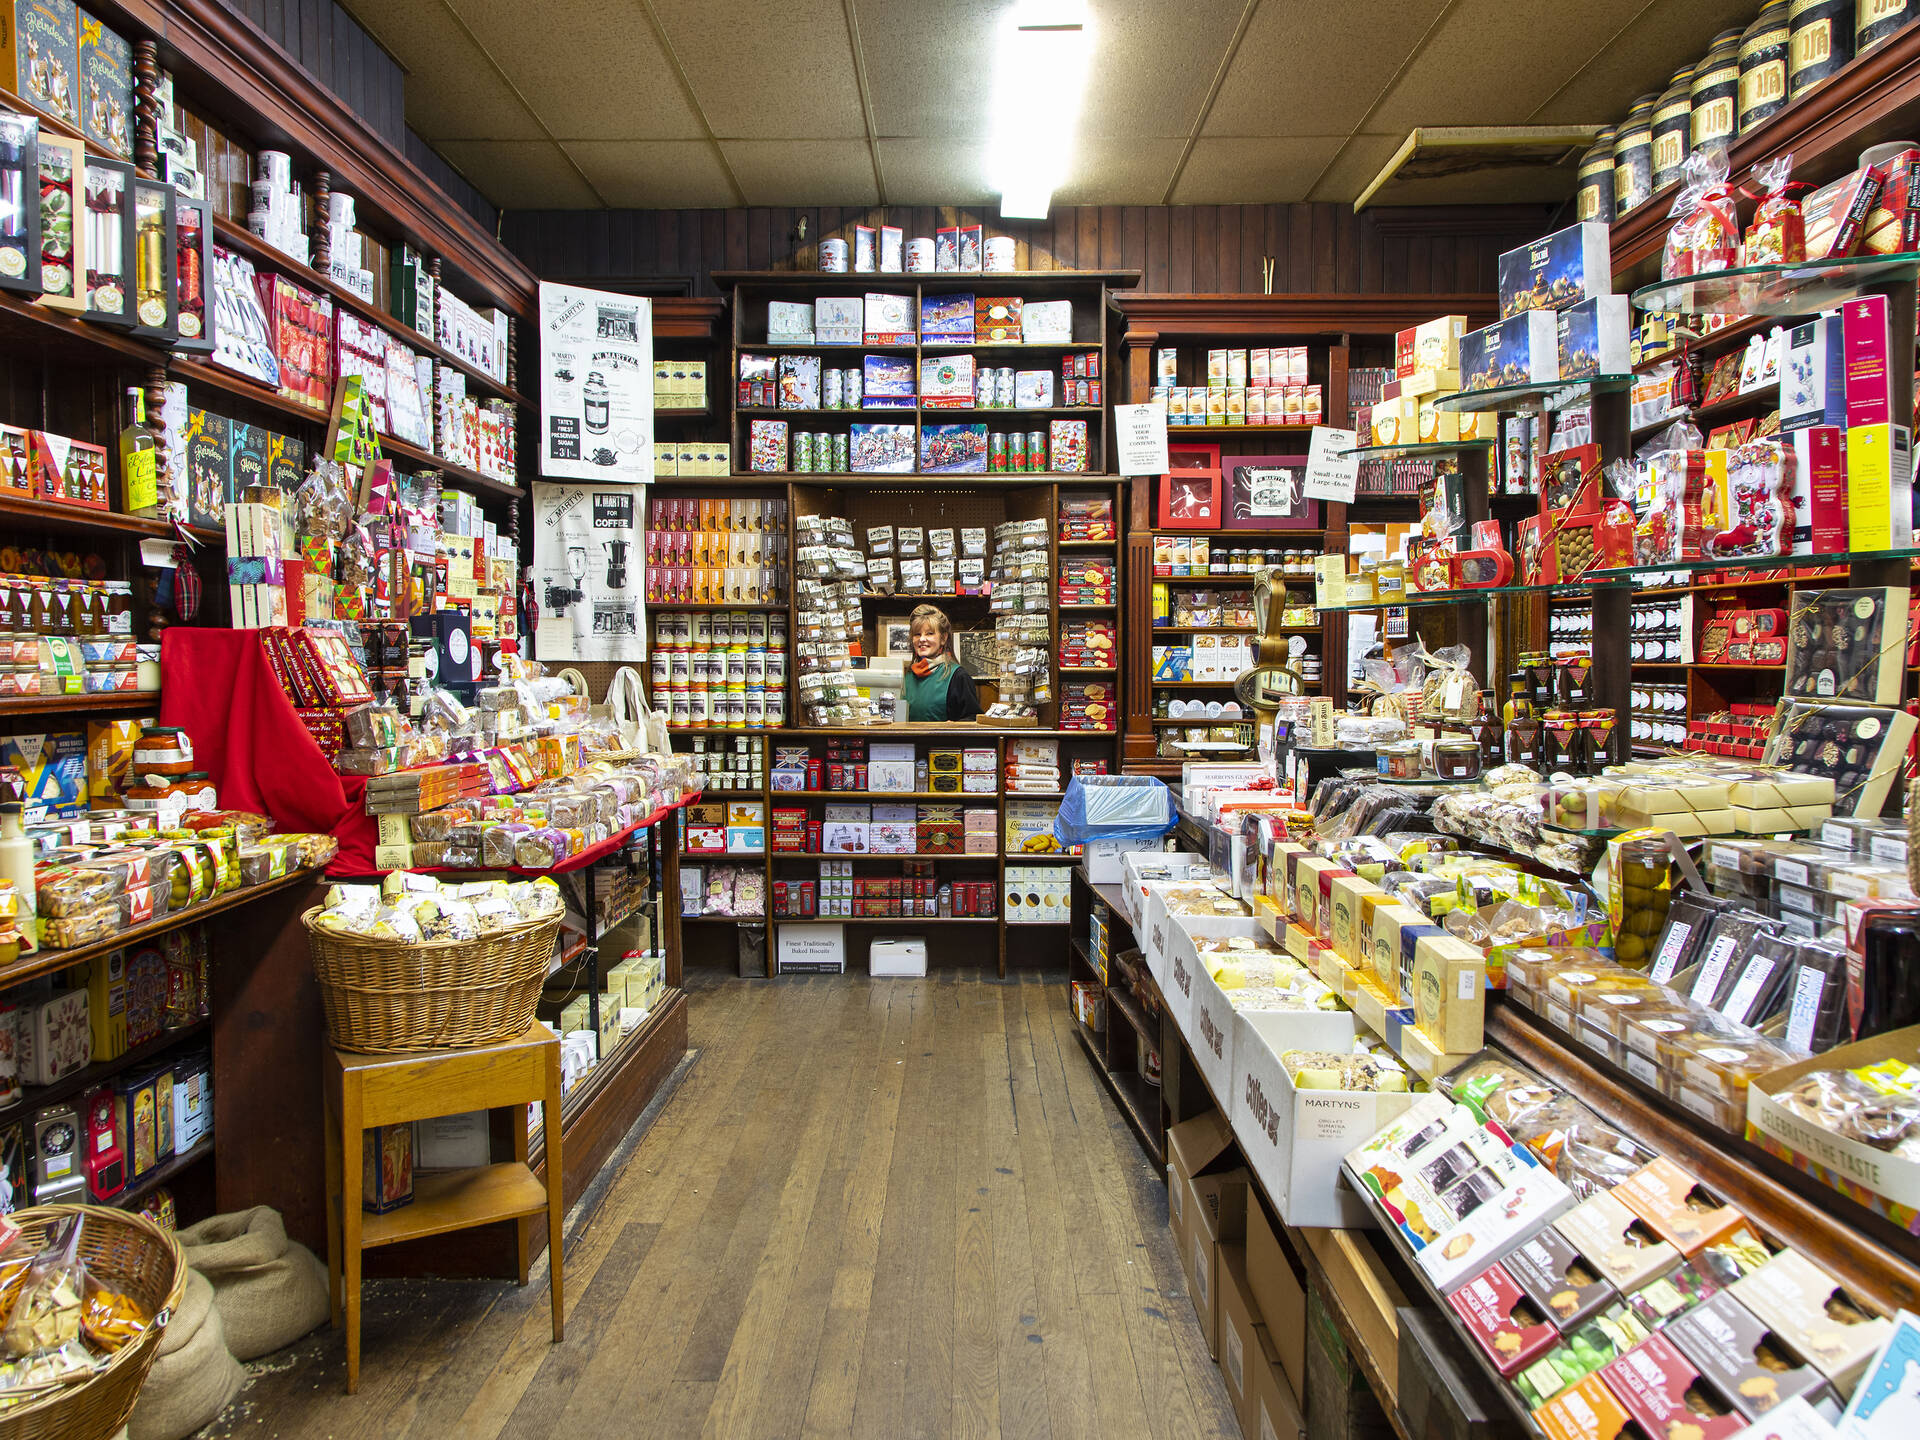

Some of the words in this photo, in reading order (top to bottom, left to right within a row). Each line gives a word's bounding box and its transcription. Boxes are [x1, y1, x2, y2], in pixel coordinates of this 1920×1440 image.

[25, 11, 68, 47] Reindeer
[89, 56, 126, 88] Reindeer
[89, 175, 123, 190] £29.75
[1854, 181, 1873, 217] SHORTBREAD
[1838, 224, 1854, 250] Walkers
[1908, 212, 1916, 242] Walkers
[559, 299, 586, 326] MARTYN
[551, 432, 579, 440] PRESERVING
[1783, 418, 1820, 431] MARSHMALLOW
[194, 444, 223, 462] Reindeer
[240, 457, 262, 473] House
[275, 466, 299, 482] Reindeer
[1313, 478, 1330, 486] Large
[546, 517, 555, 527] W.
[556, 489, 584, 518] MARTYN
[595, 519, 629, 528] COFFEE
[1200, 1004, 1215, 1050] coffee
[1246, 1072, 1268, 1131] coffee
[1305, 1099, 1361, 1110] MARTYNS
[1761, 1106, 1812, 1153] CELEBRATE
[1814, 1136, 1837, 1165] THE
[1839, 1150, 1881, 1186] TASTE
[1460, 1286, 1482, 1313] GINGER
[1478, 1307, 1498, 1333] THINS
[1614, 1360, 1645, 1396] GINGER
[1639, 1387, 1671, 1421] THINS
